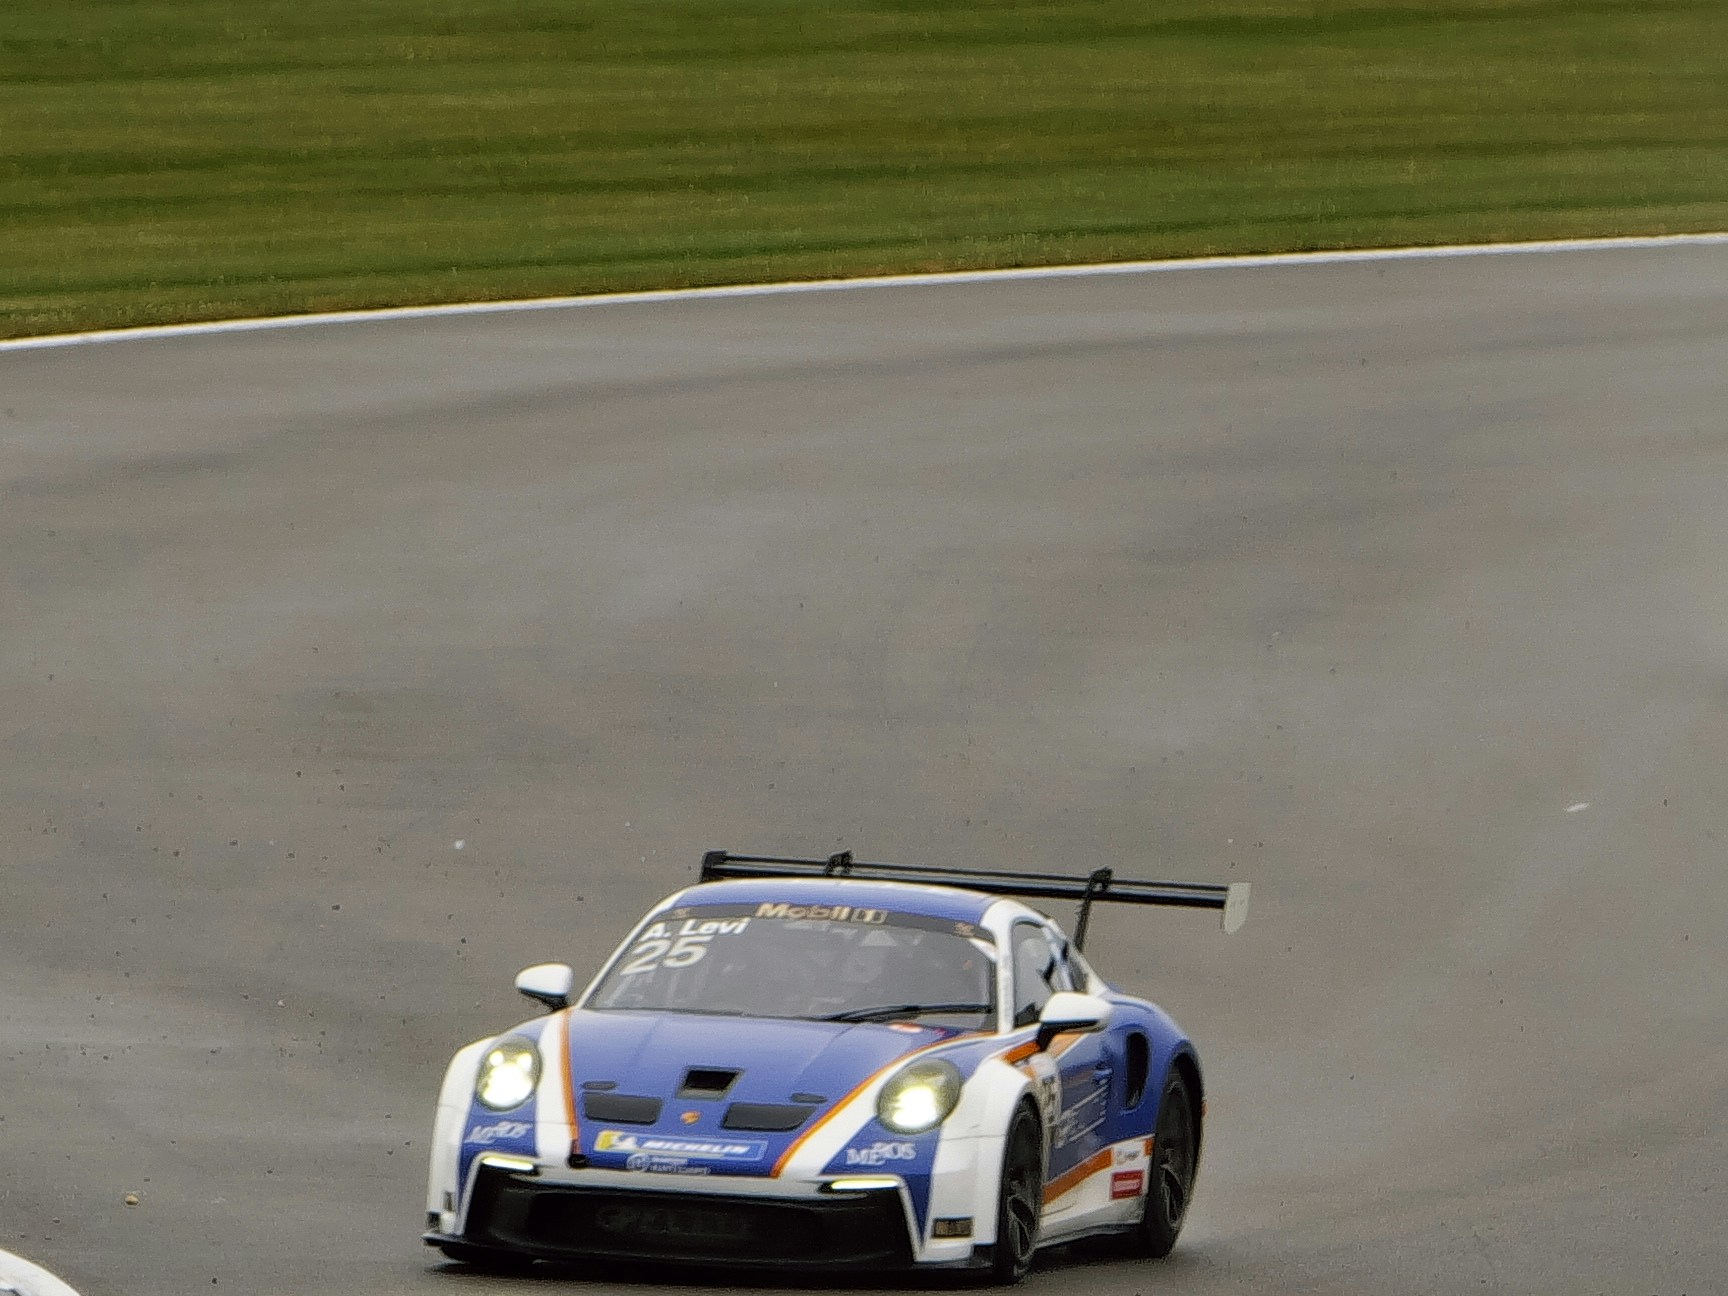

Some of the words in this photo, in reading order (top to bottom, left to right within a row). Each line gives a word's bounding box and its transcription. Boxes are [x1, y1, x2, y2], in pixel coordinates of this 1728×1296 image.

[755, 902, 849, 922] Mobil
[641, 922, 671, 942] A.
[679, 916, 751, 937] Levi
[620, 934, 715, 976] 25
[641, 1140, 752, 1155] MICHELIN
